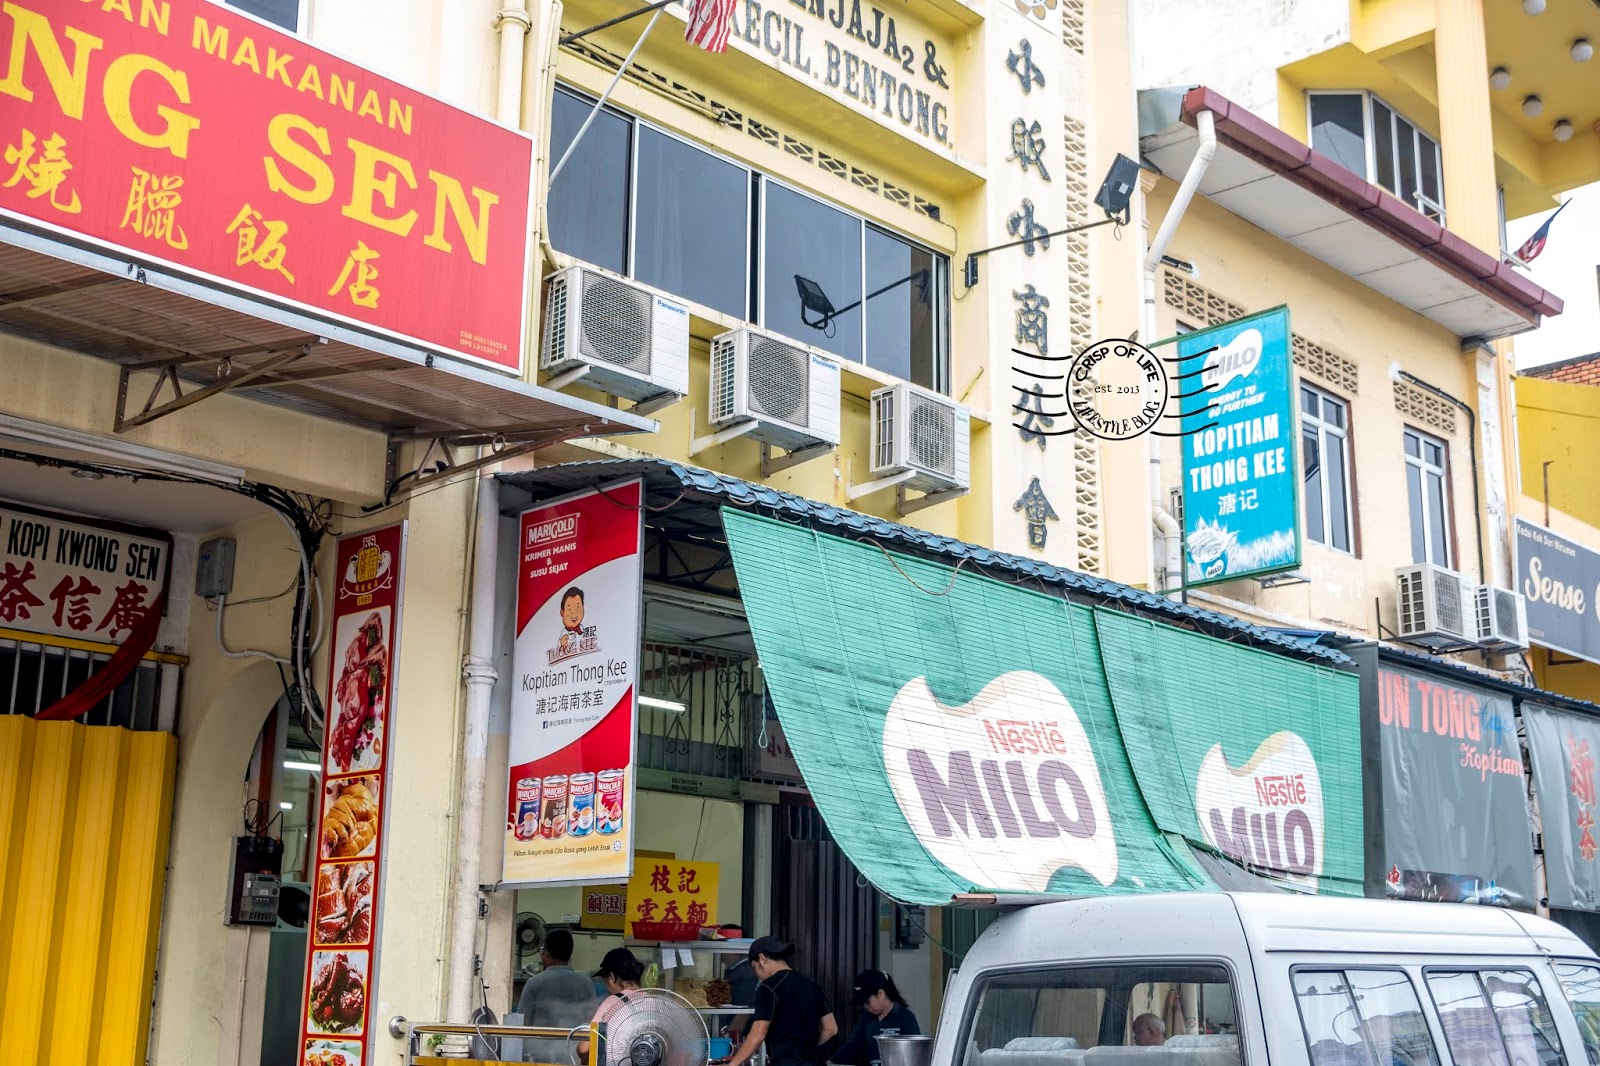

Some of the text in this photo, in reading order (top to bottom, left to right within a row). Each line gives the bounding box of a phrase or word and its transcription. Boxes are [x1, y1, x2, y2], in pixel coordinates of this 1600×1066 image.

[80, 0, 413, 135] AN MAKANAN
[923, 40, 949, 90] &
[263, 113, 499, 266] SEN
[657, 299, 687, 317] Panasonic
[812, 357, 838, 372] Panasonic
[1207, 346, 1257, 381] MILO
[1208, 385, 1257, 407] ENERGY TO
[1208, 392, 1266, 418] GO FURTHER
[1193, 413, 1279, 458] KOPITIAM
[1190, 447, 1286, 493] THONG KEE
[528, 517, 575, 546] MARIGOLD
[7, 518, 160, 581] KOPI KWONG SEN
[524, 542, 577, 562] KRIMER MANIS
[546, 557, 552, 566] &
[530, 562, 568, 578] SUSU SEJAT
[1524, 556, 1586, 615] Sense
[579, 637, 598, 652] KEE
[522, 658, 627, 694] Kopitiam Thong Kee
[535, 688, 604, 715] 溏记海南茶室
[1416, 678, 1480, 741] TONG
[518, 787, 539, 800] MARIGOLD
[544, 785, 566, 798] MARIGOLD
[570, 783, 593, 796] MARIGOLD
[598, 780, 621, 792] MARIGOLD
[906, 748, 1097, 839] MILO
[1209, 807, 1314, 876] MILO
[650, 864, 701, 894] 枝記
